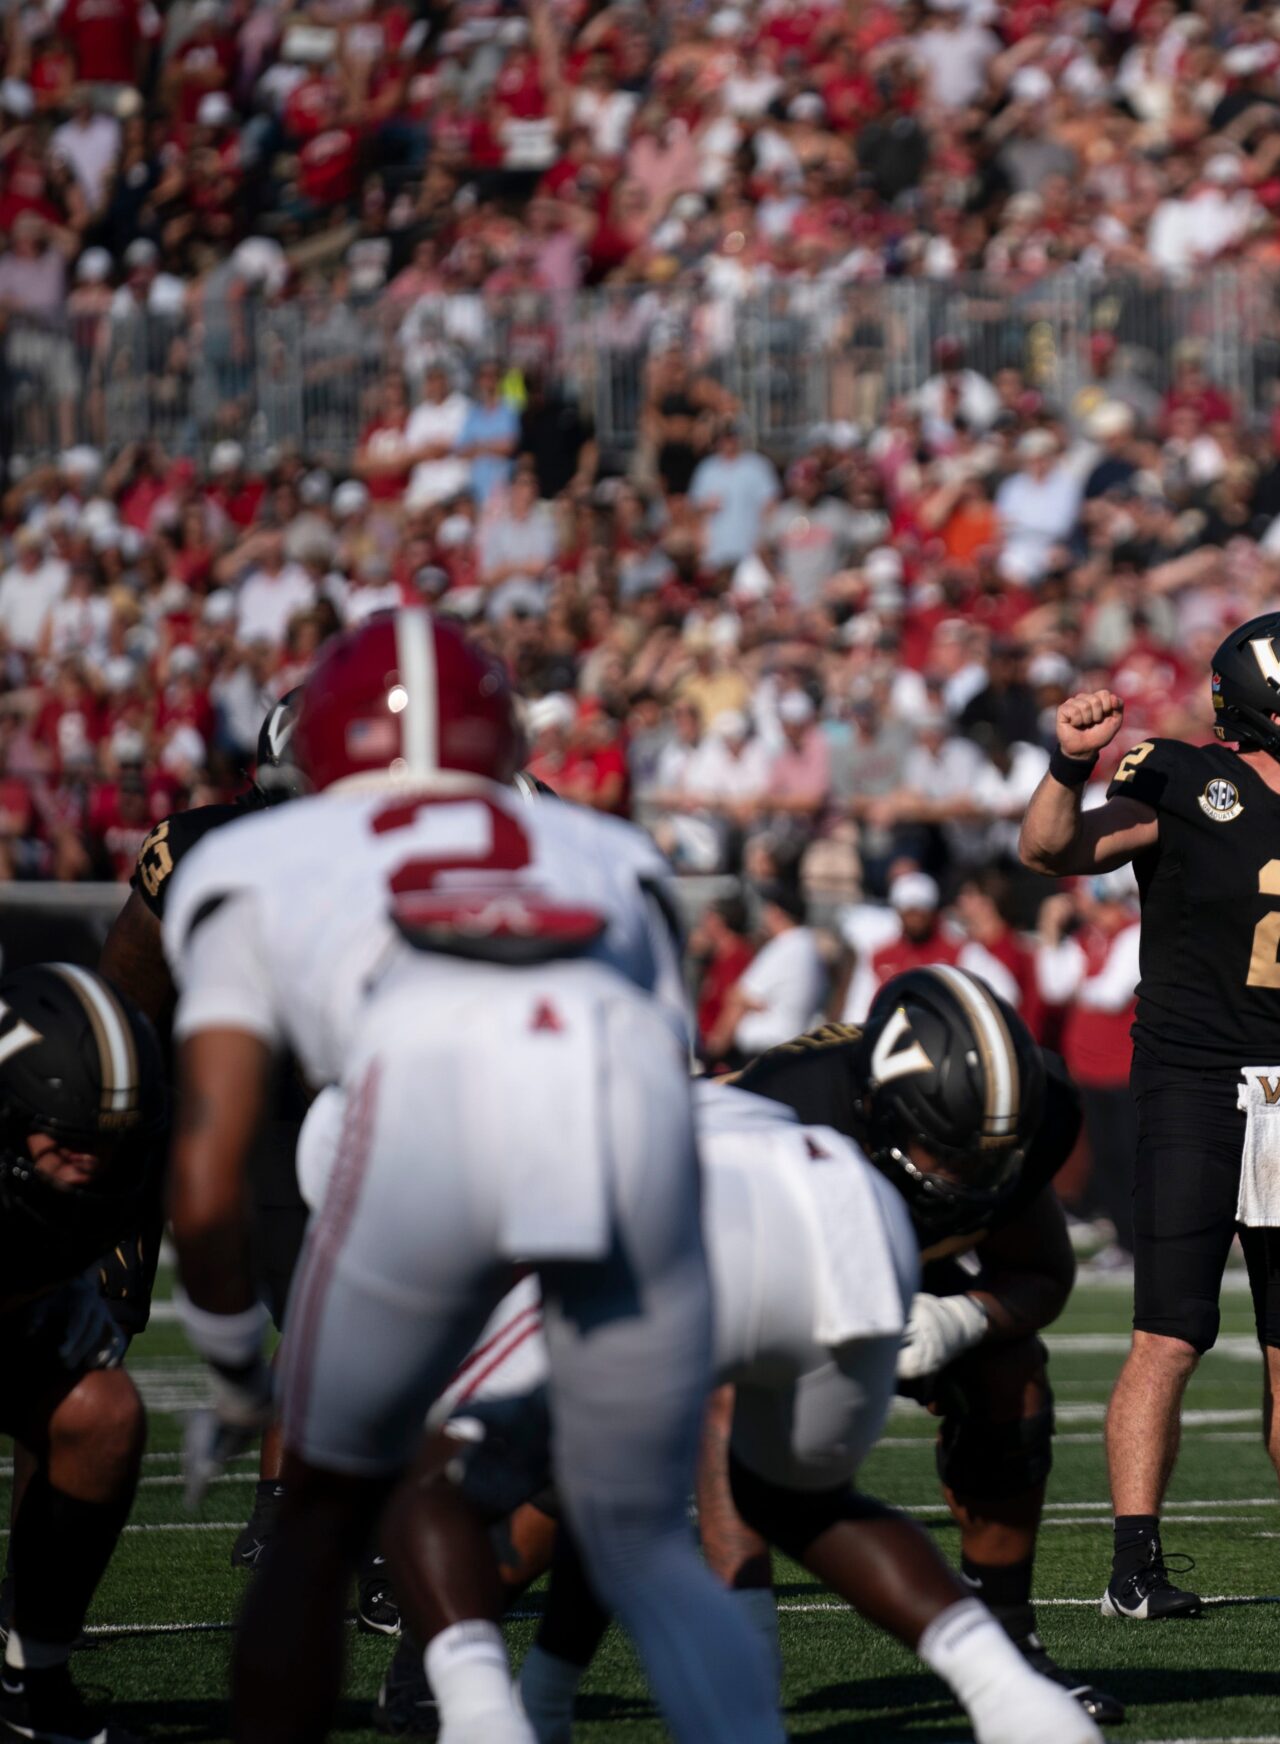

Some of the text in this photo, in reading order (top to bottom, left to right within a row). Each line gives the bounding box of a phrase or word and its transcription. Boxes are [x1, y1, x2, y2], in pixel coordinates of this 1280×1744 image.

[1114, 742, 1155, 782] 2
[1202, 803, 1236, 821] GRADUATE
[1207, 780, 1236, 811] SEC
[371, 790, 533, 896] 2
[871, 1007, 934, 1084] V
